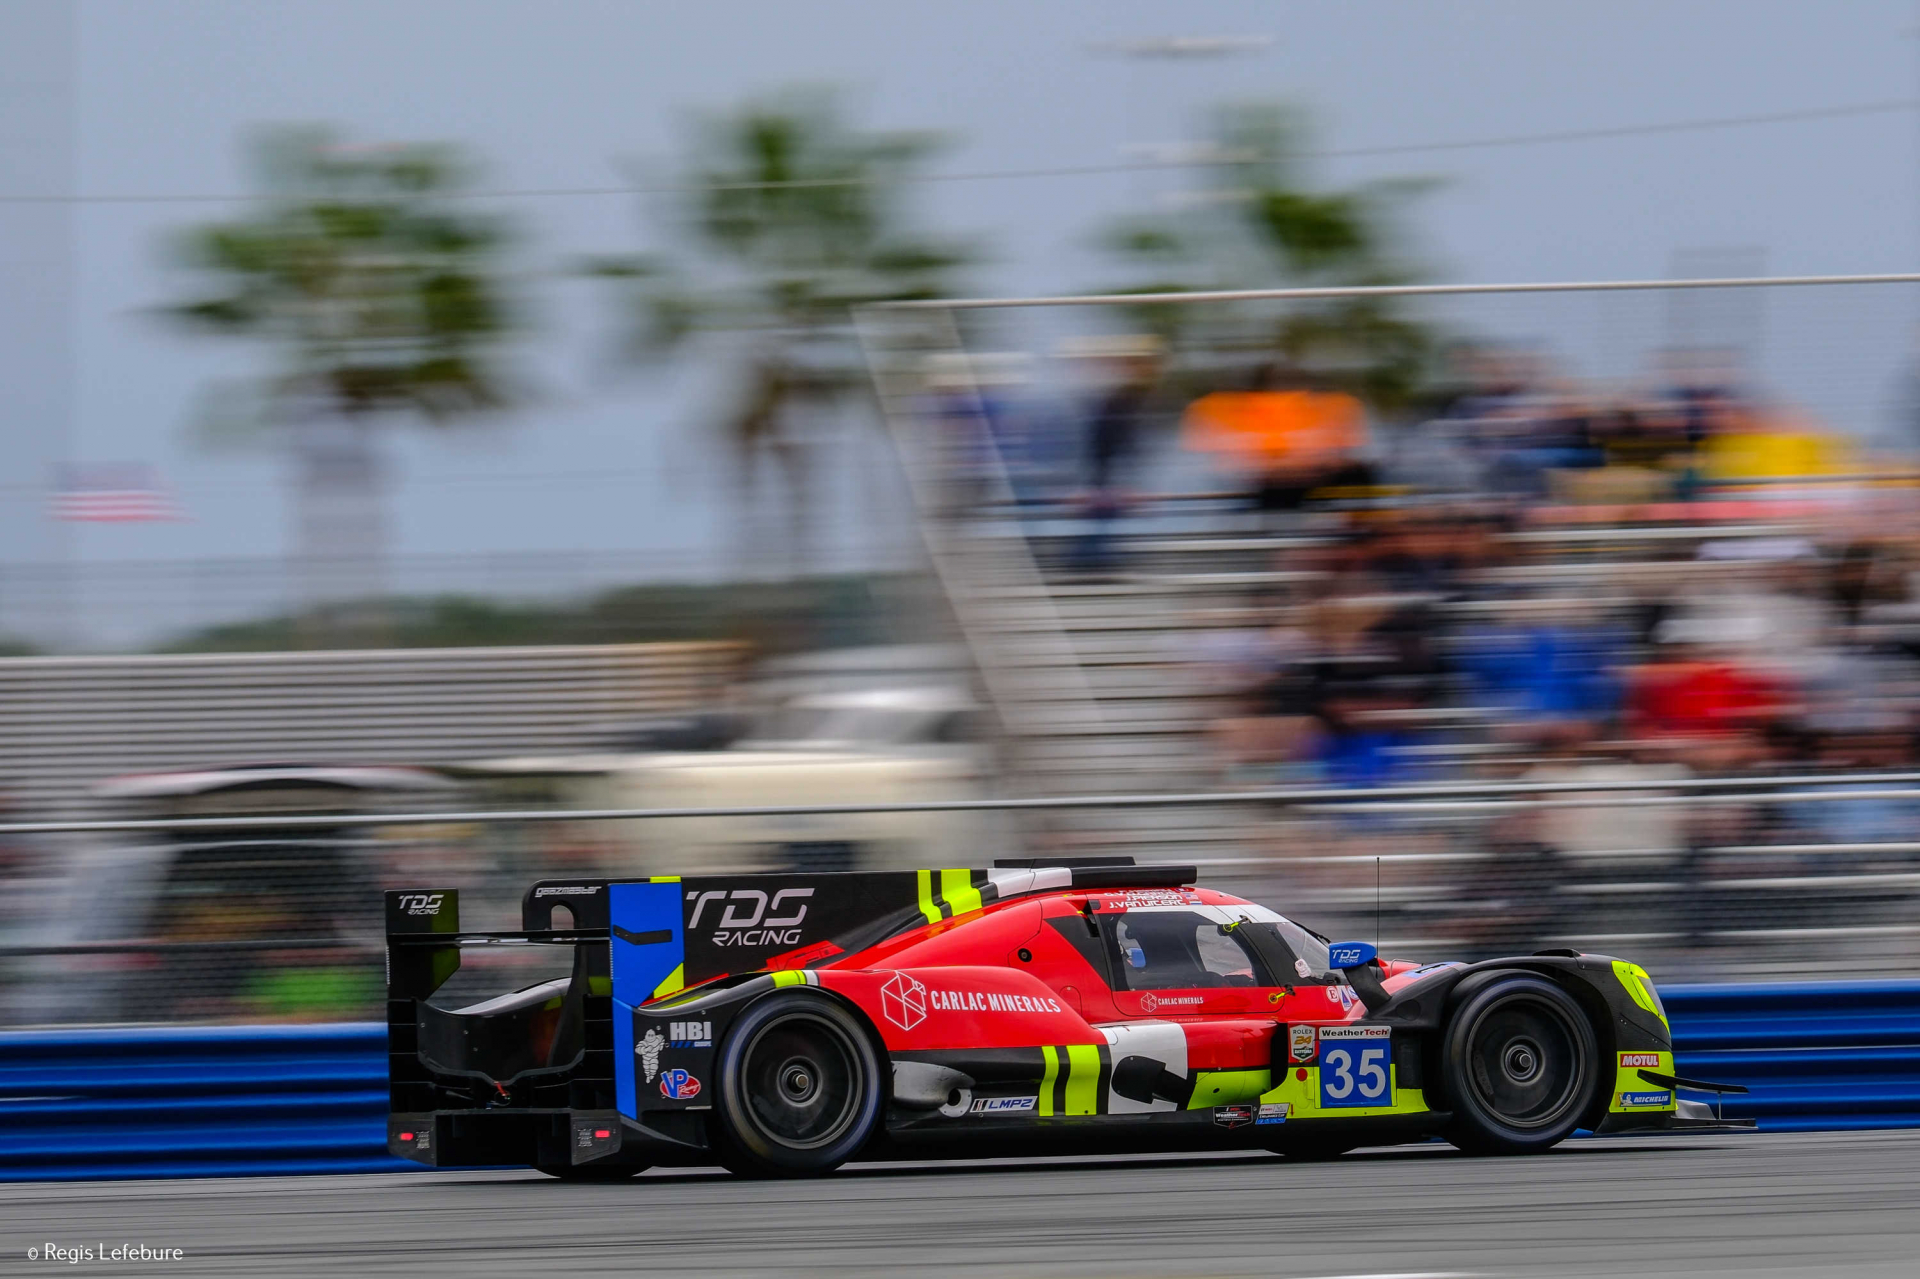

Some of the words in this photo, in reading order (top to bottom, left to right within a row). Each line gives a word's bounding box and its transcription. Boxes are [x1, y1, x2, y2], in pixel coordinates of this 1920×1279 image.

[398, 895, 444, 909] TDS
[686, 888, 815, 929] TDS
[712, 929, 802, 946] RACING
[1332, 949, 1361, 959] TDS
[931, 990, 986, 1010] CARLAC
[988, 994, 1061, 1012] MINERALS
[1157, 998, 1178, 1006] CARLAC
[1178, 996, 1204, 1005] MINERALS
[670, 1021, 712, 1041] HBI
[1322, 1028, 1388, 1037] WeatherTech
[1294, 1035, 1312, 1045] 24
[1622, 1055, 1658, 1066] MOTUL
[1325, 1048, 1386, 1099] 35
[660, 1068, 690, 1099] VP
[988, 1098, 1033, 1109] LMP2
